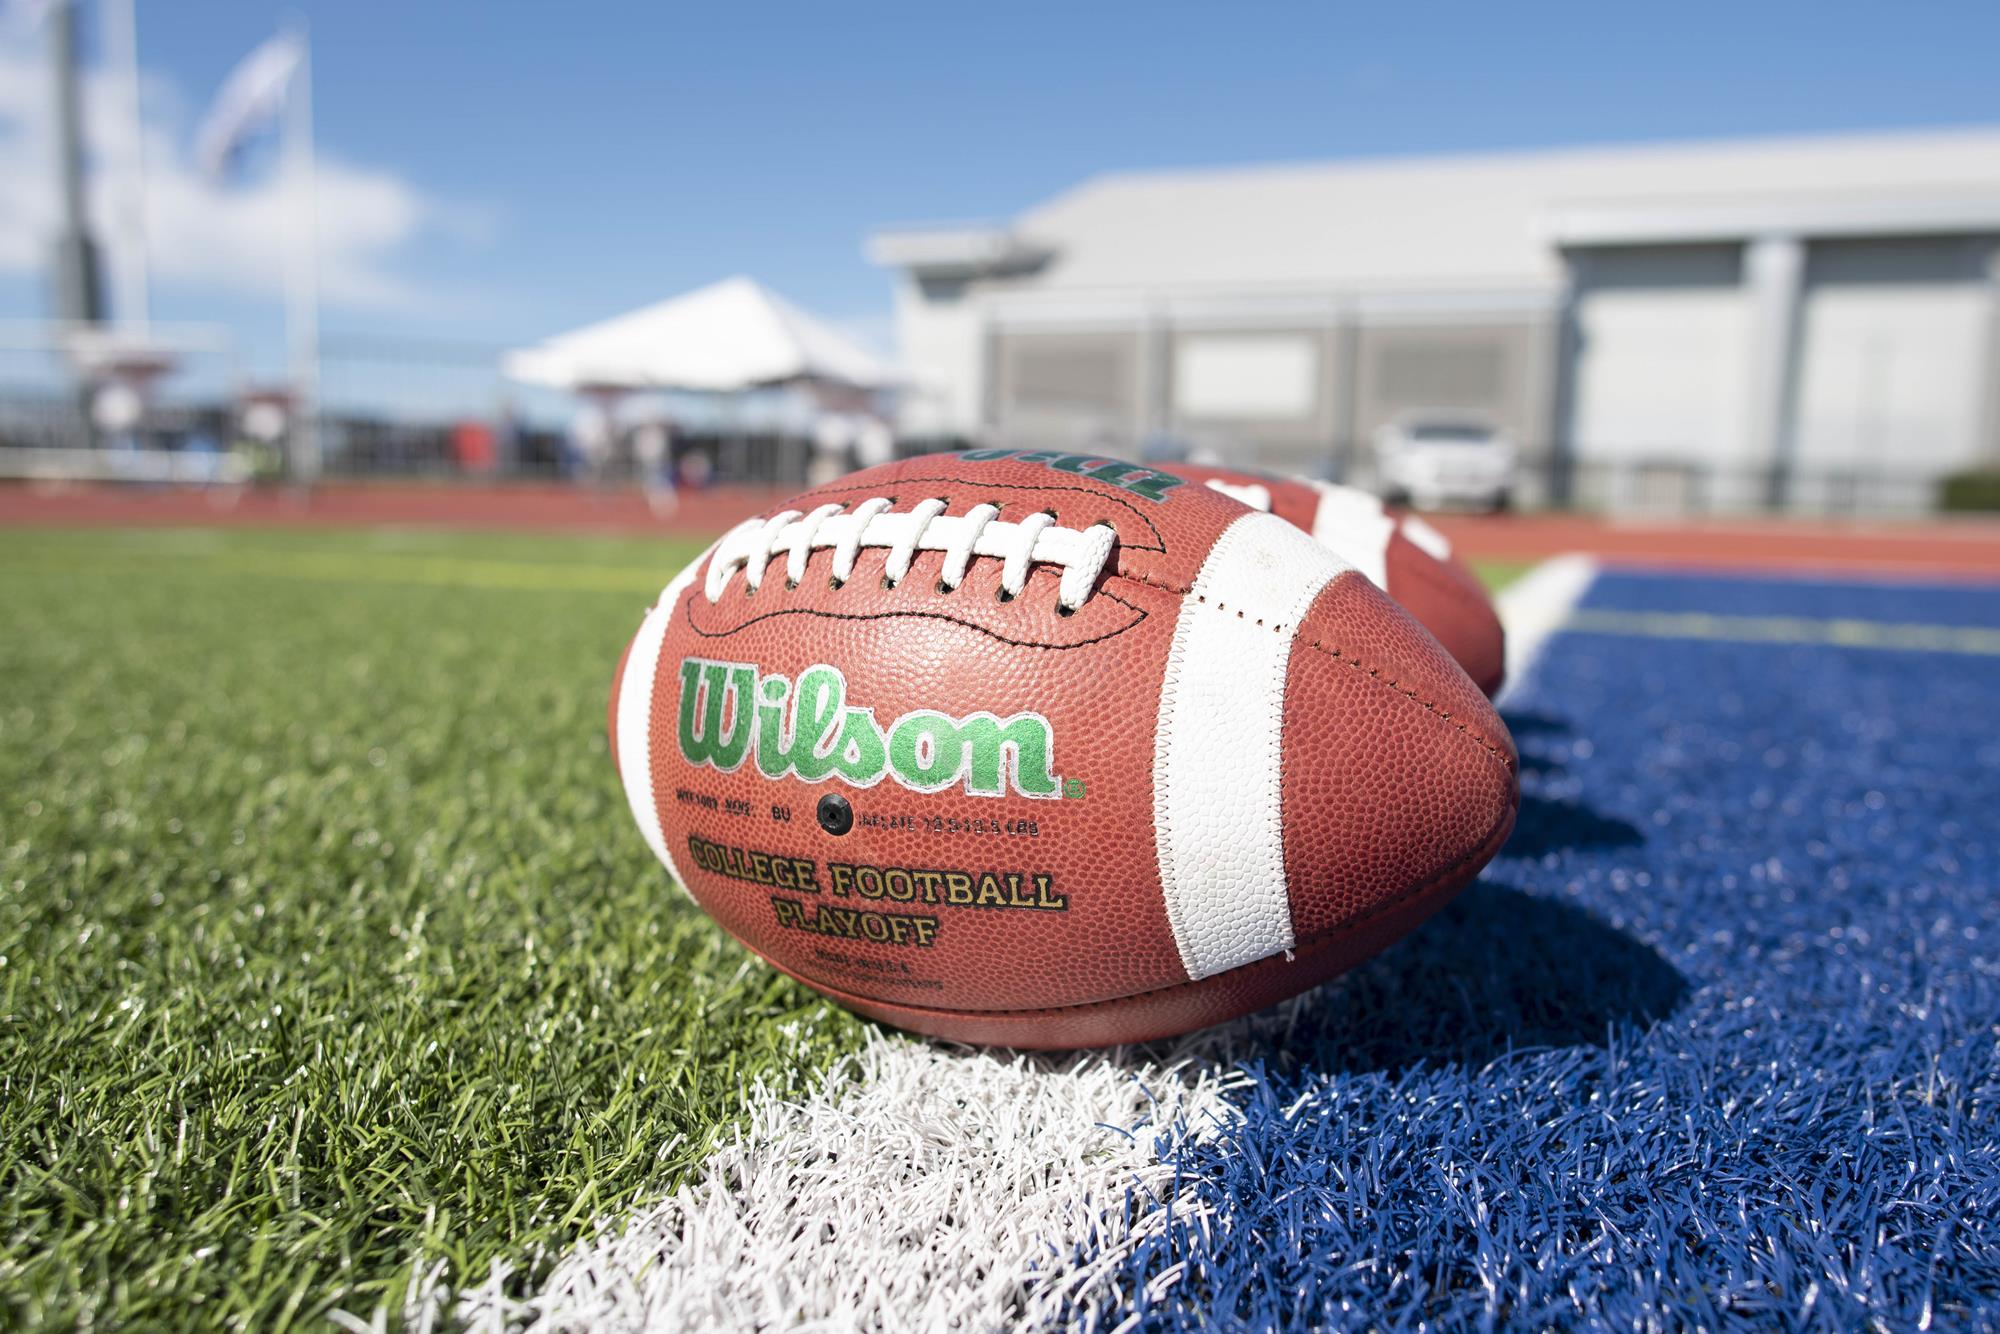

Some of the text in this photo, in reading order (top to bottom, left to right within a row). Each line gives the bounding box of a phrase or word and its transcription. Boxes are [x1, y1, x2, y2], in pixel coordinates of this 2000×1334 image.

[678, 658, 1062, 799] Wilson
[688, 835, 1069, 911] COLLEGE FOOTBALL
[770, 895, 939, 947] PLAYOFF
